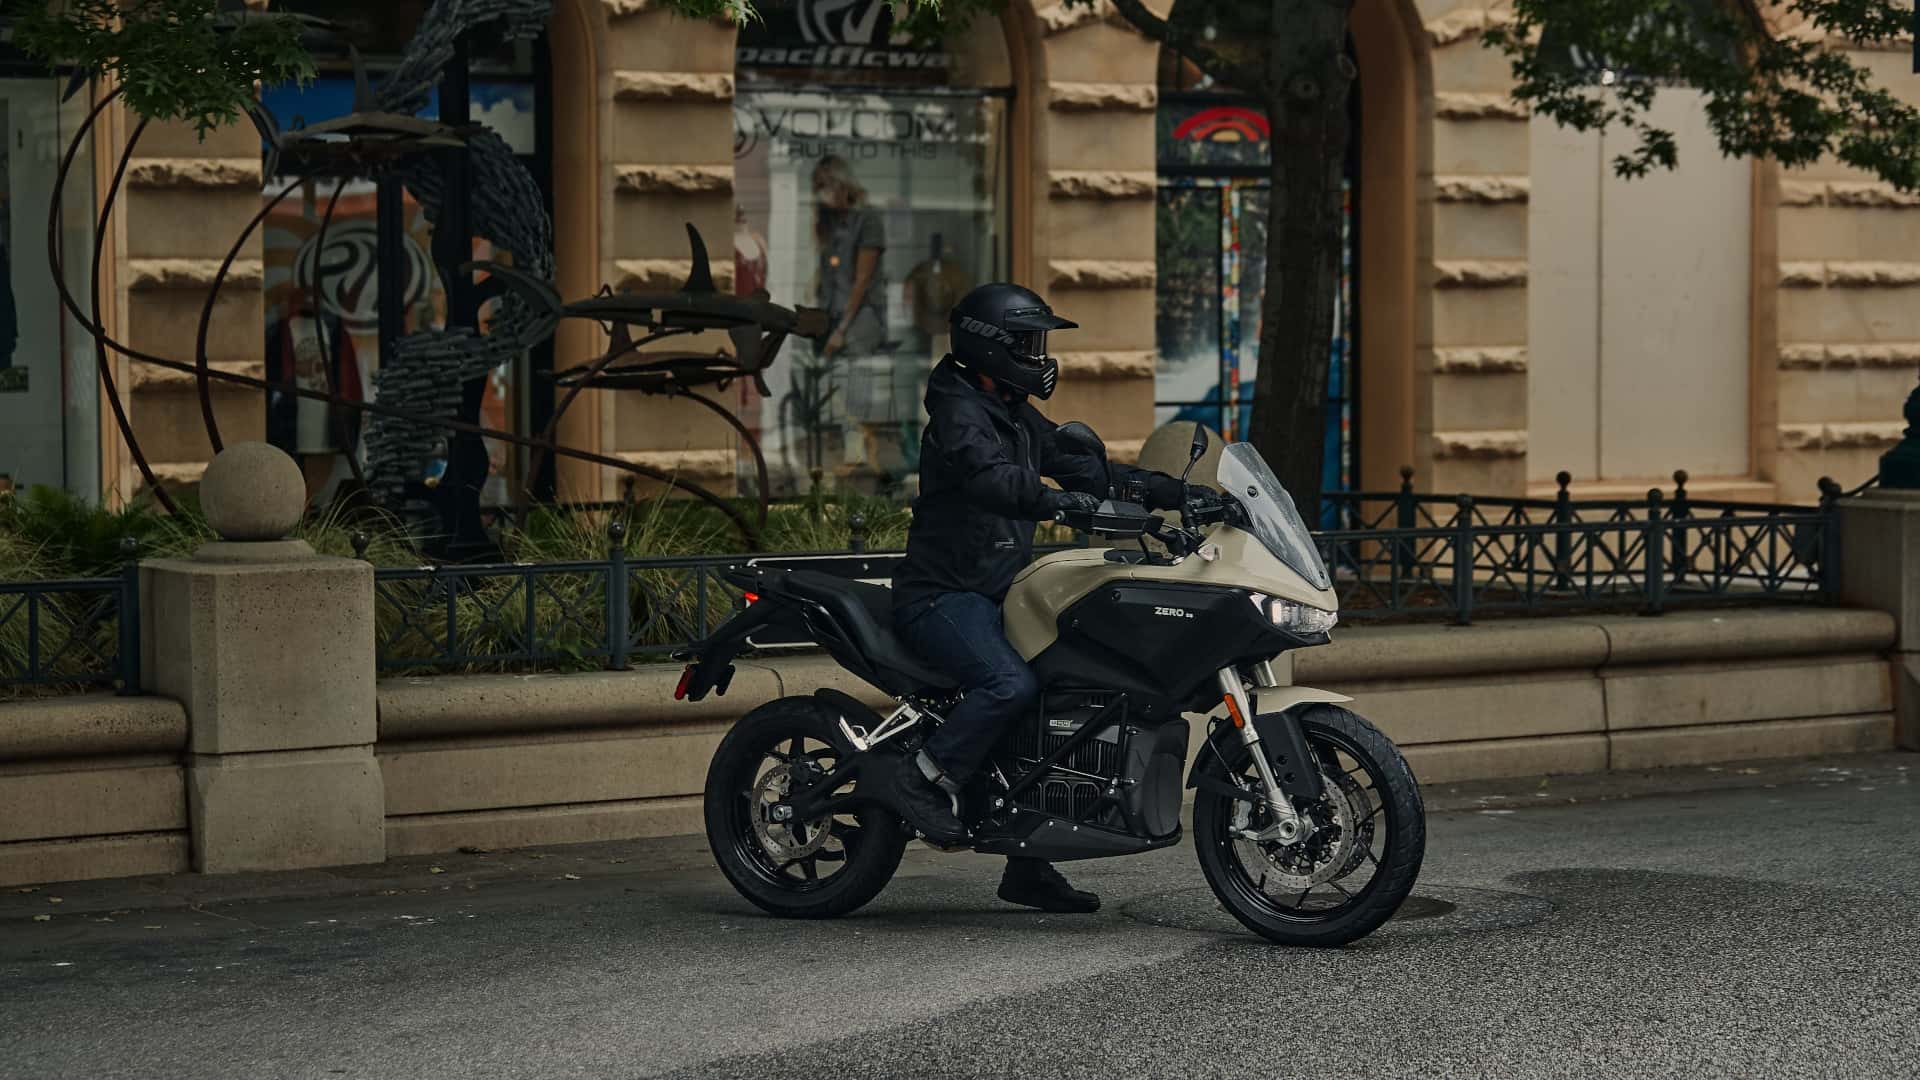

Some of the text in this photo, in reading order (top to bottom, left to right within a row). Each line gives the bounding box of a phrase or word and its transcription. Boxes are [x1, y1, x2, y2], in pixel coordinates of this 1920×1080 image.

[847, 142, 876, 159] TO
[888, 142, 937, 161] THIS
[960, 316, 1015, 345] 100%
[1154, 606, 1184, 617] ZERO
